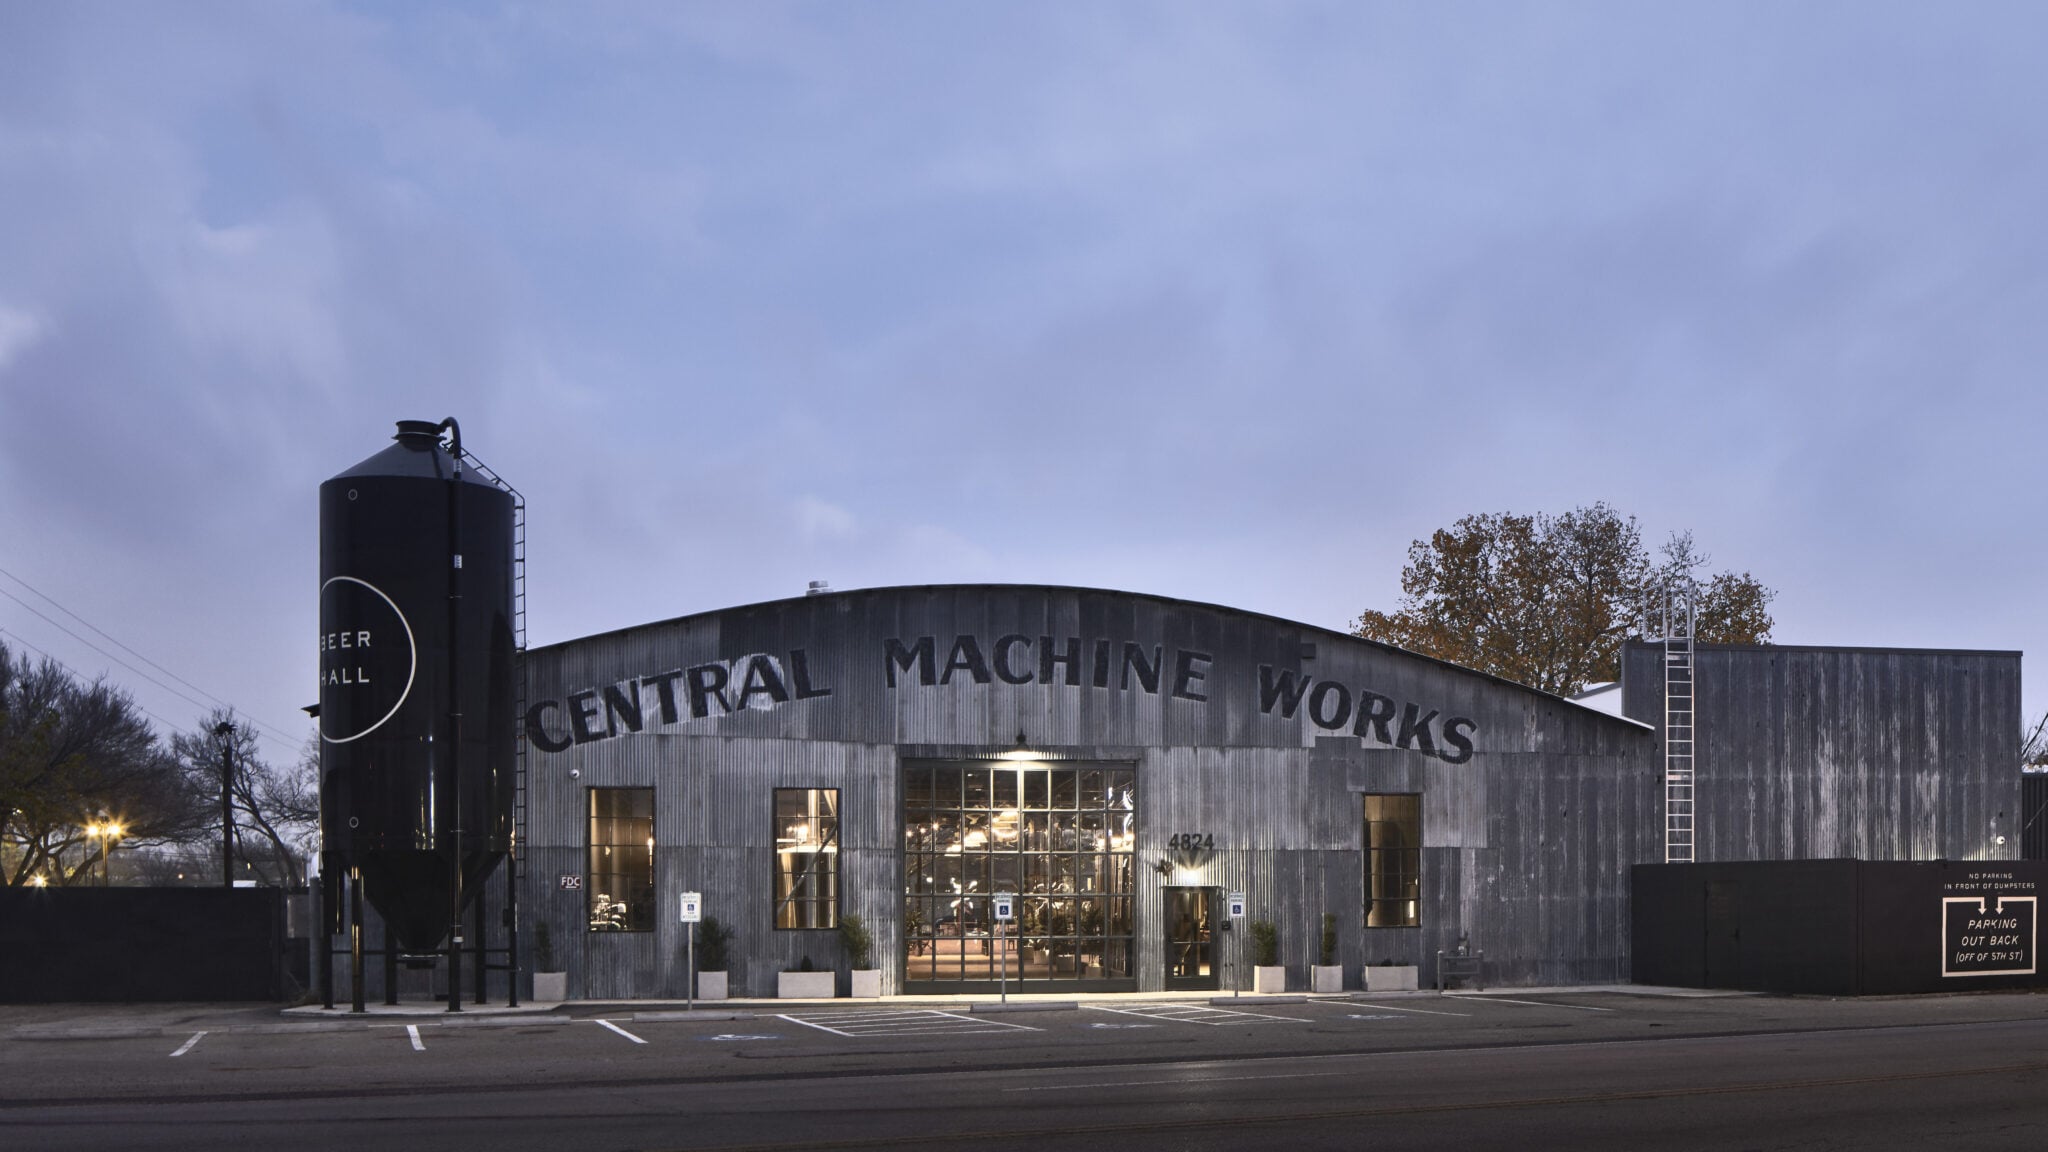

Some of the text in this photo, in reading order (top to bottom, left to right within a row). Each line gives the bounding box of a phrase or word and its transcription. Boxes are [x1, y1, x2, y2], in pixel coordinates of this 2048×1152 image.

[321, 631, 371, 652] BEER
[321, 667, 370, 686] HALL
[525, 634, 1478, 765] CENTRAL MACHINE WORKS
[1169, 833, 1214, 850] 4824
[561, 876, 580, 886] FDC
[1967, 918, 2017, 930] PARKING
[1961, 935, 2019, 946] OUT BACK
[1956, 948, 2023, 964] (OFF OF 5TH ST)
